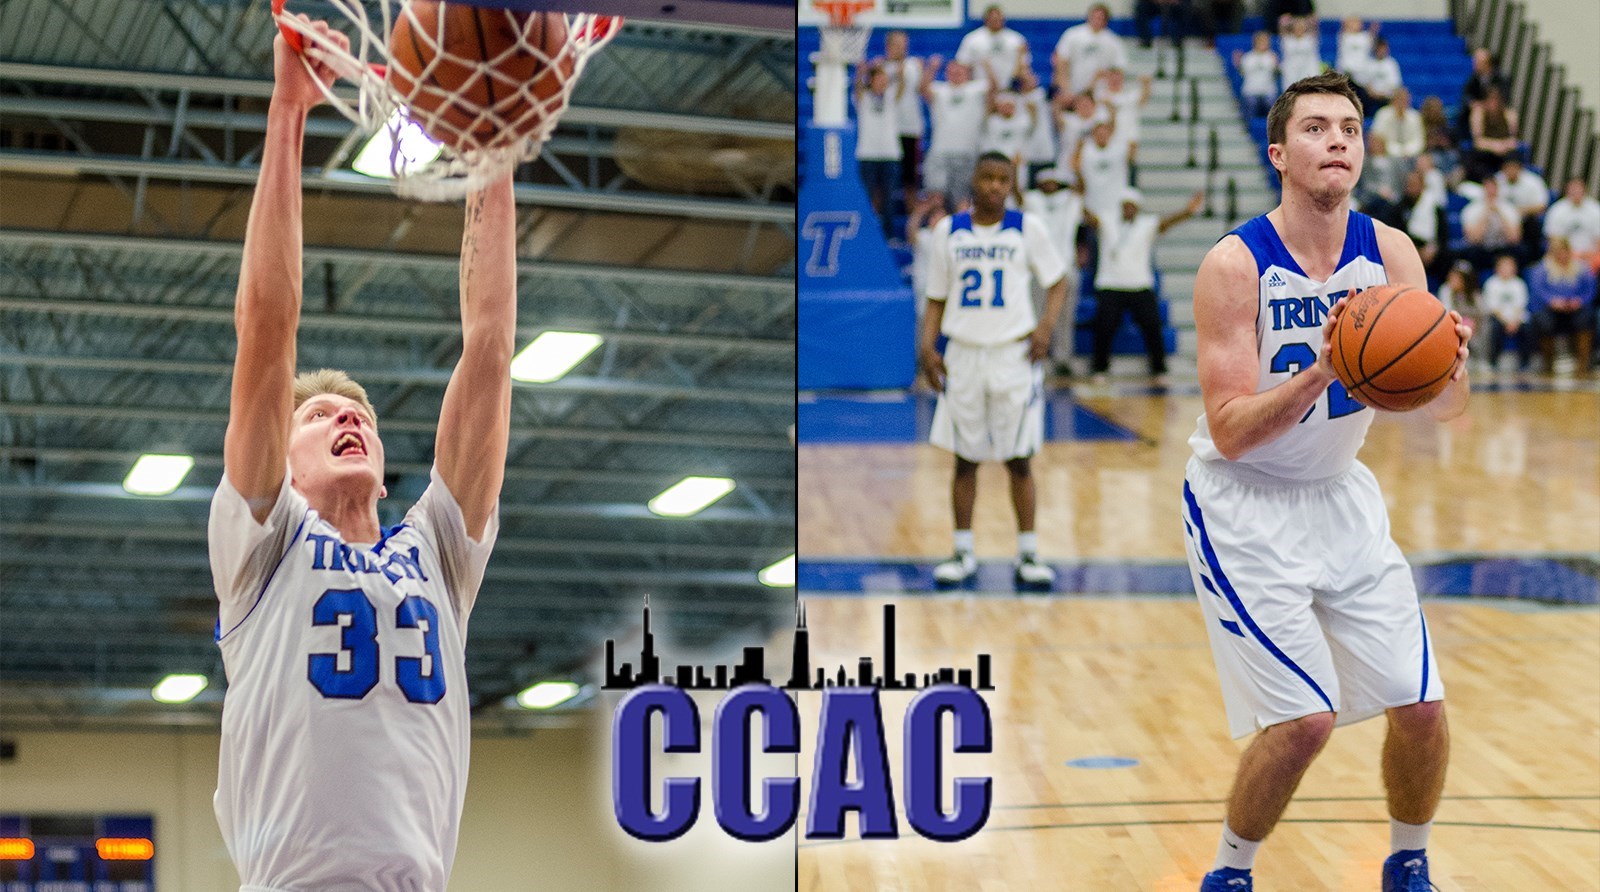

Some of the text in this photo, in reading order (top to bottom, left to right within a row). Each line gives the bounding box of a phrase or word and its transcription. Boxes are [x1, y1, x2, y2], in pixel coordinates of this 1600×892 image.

[956, 246, 1015, 260] TRINITY
[961, 269, 1004, 307] 21
[1268, 286, 1374, 331] TRIN
[307, 588, 446, 705] 33
